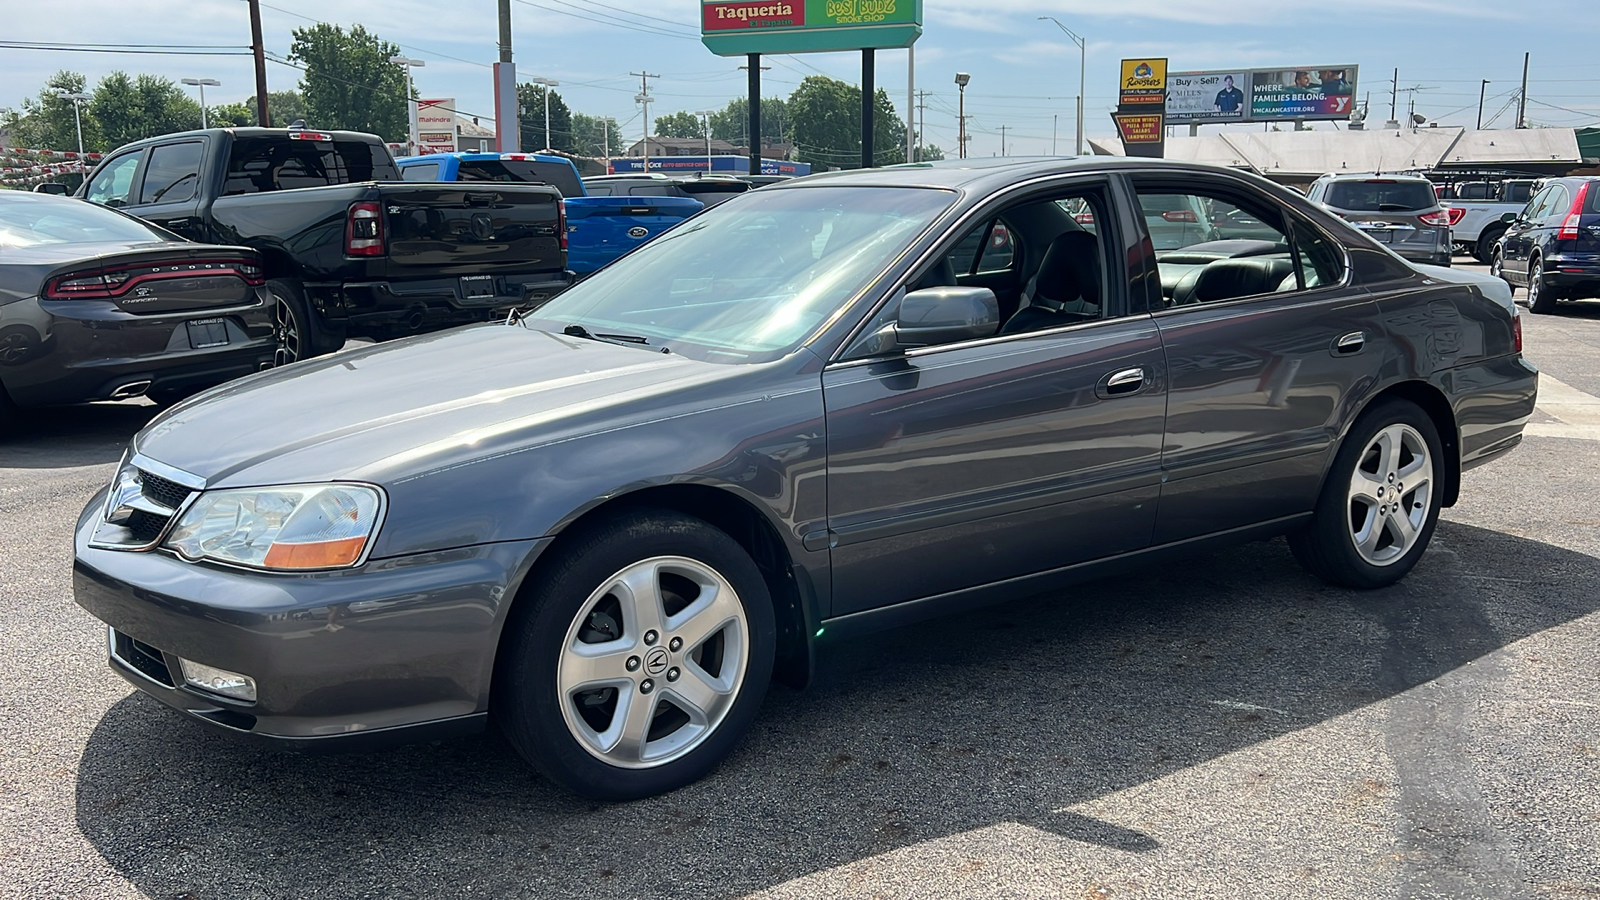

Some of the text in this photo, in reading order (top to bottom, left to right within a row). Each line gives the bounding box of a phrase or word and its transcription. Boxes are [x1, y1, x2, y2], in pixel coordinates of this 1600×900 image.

[836, 14, 885, 24] SMOKE SHOP
[1126, 76, 1161, 89] Roosters
[1176, 78, 1192, 87] Buy
[1200, 76, 1219, 85] Sell?
[1254, 84, 1283, 93] WHERE
[1253, 93, 1327, 103] FAMILIES BELONG.
[1253, 106, 1315, 114] YMCALANCASTER.ORG
[152, 264, 226, 272] DODGE
